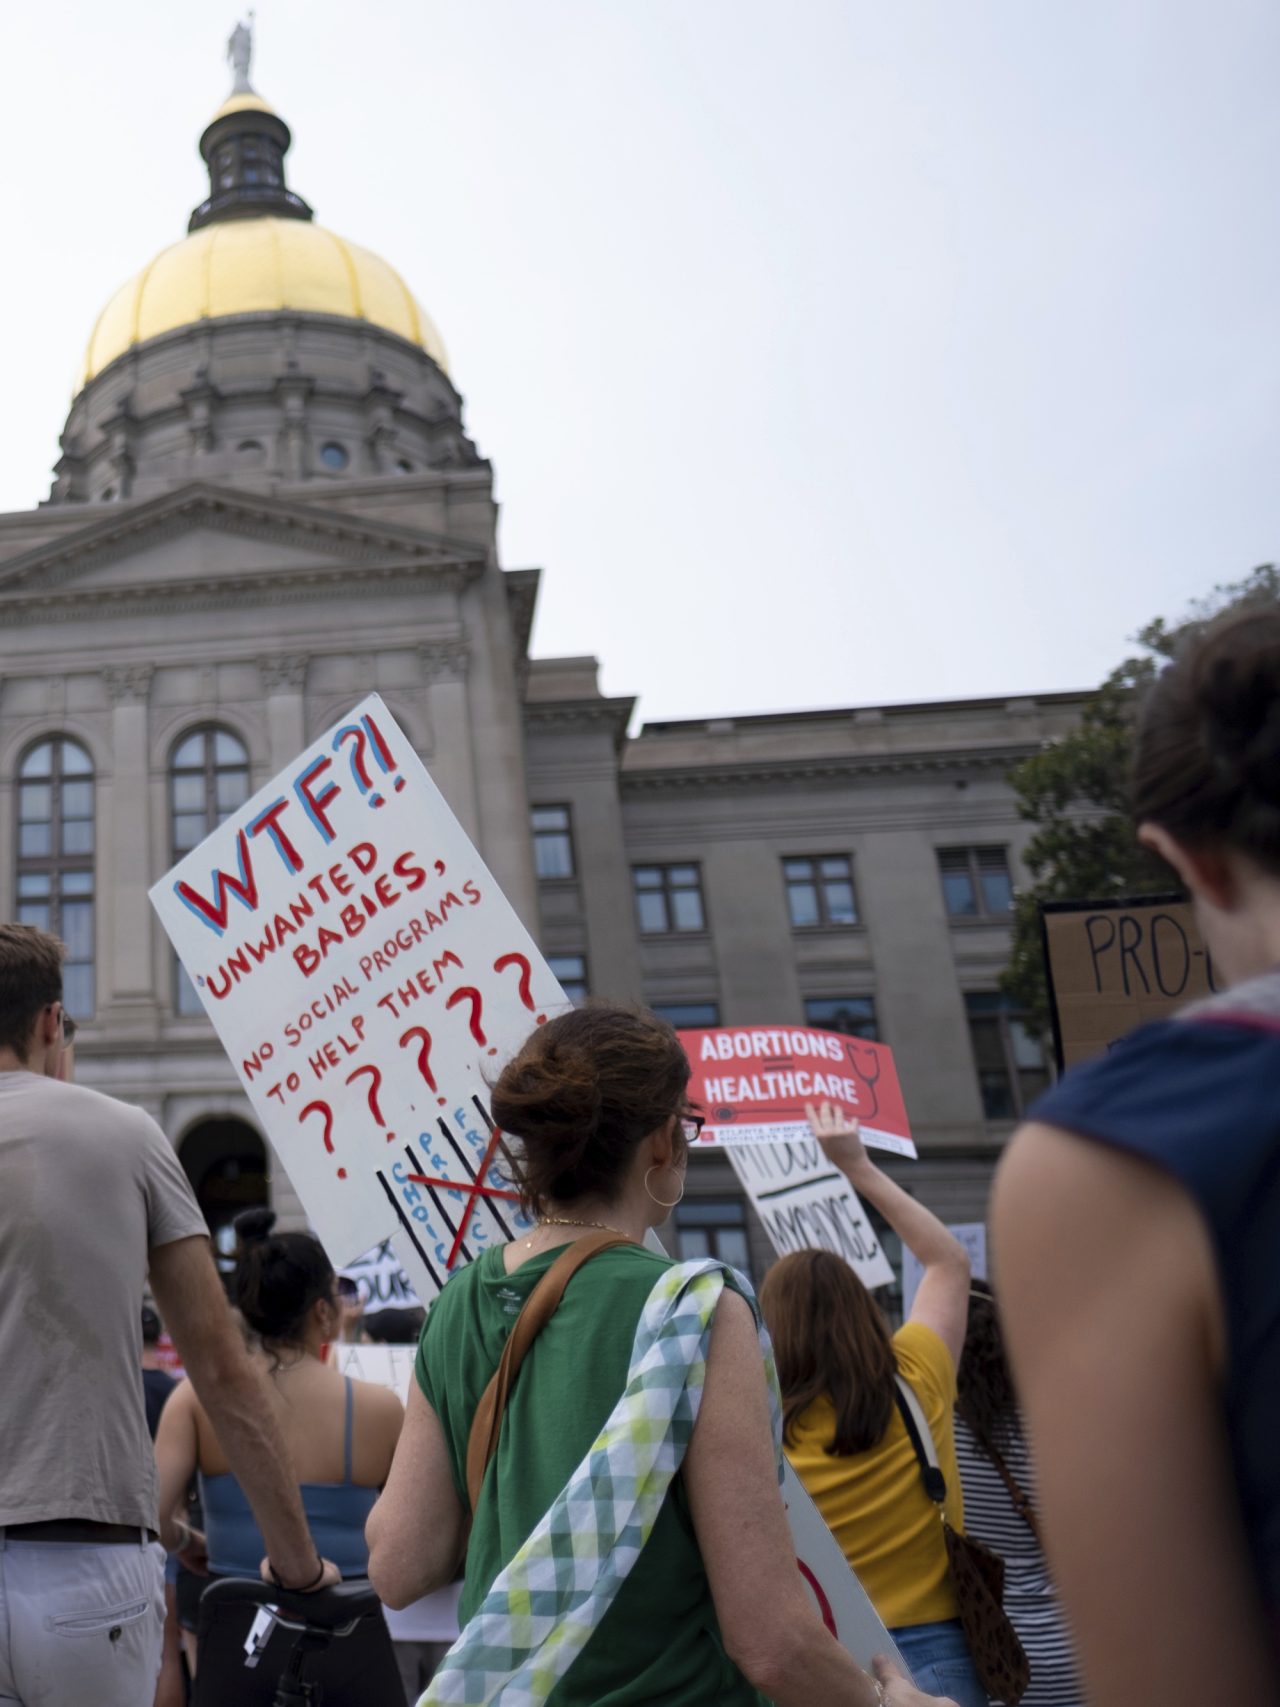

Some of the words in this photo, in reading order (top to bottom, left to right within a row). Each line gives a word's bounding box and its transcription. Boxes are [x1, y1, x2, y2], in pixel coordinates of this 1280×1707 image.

[173, 714, 406, 937] WTF?!
[205, 842, 379, 999] UNWANTED
[242, 1042, 275, 1081] NO
[284, 977, 359, 1047] SOCIAL
[359, 880, 482, 981] PROGRAMS
[292, 851, 446, 978] BABIES,
[266, 1072, 300, 1104] TO
[308, 1015, 365, 1080] HELP
[377, 950, 465, 1018] THEM
[700, 1030, 845, 1062] ABORTIONS
[704, 1070, 859, 1105] HEALTHCARE
